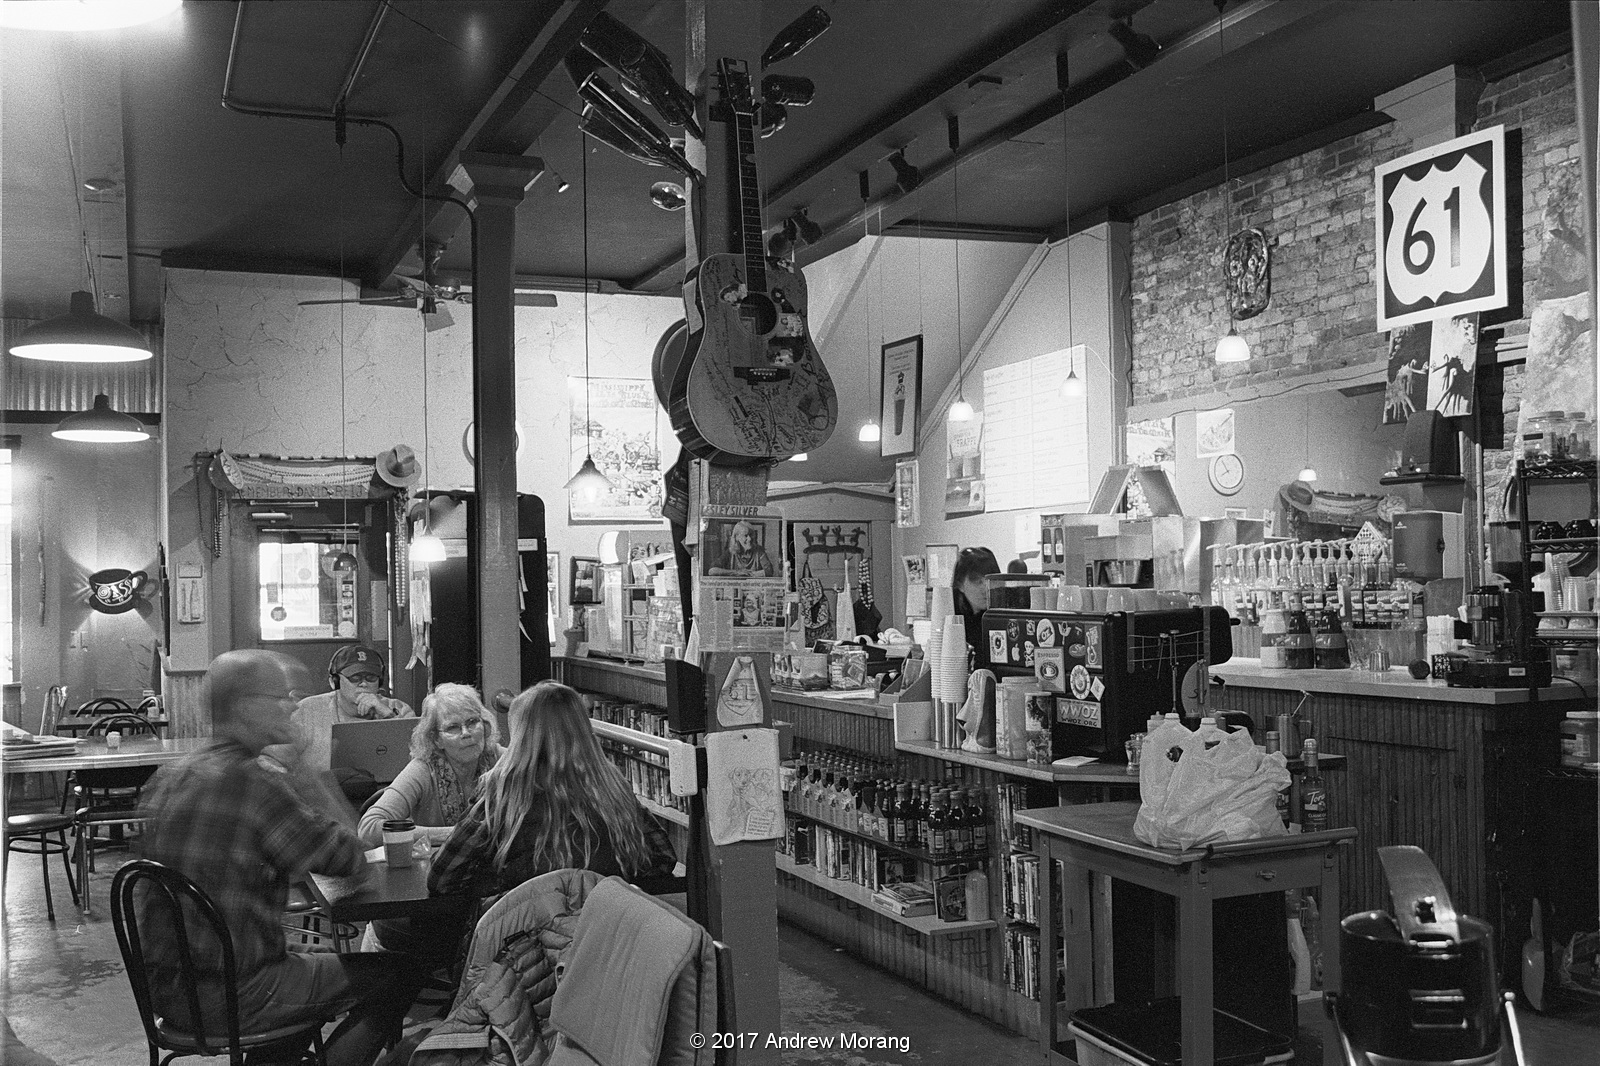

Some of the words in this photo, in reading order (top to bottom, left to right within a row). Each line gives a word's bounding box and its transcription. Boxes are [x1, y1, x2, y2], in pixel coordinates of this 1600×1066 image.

[1403, 186, 1461, 276] 61
[297, 486, 329, 498] DAVID
[731, 505, 758, 516] SILVER
[1060, 704, 1099, 719] WWOZ
